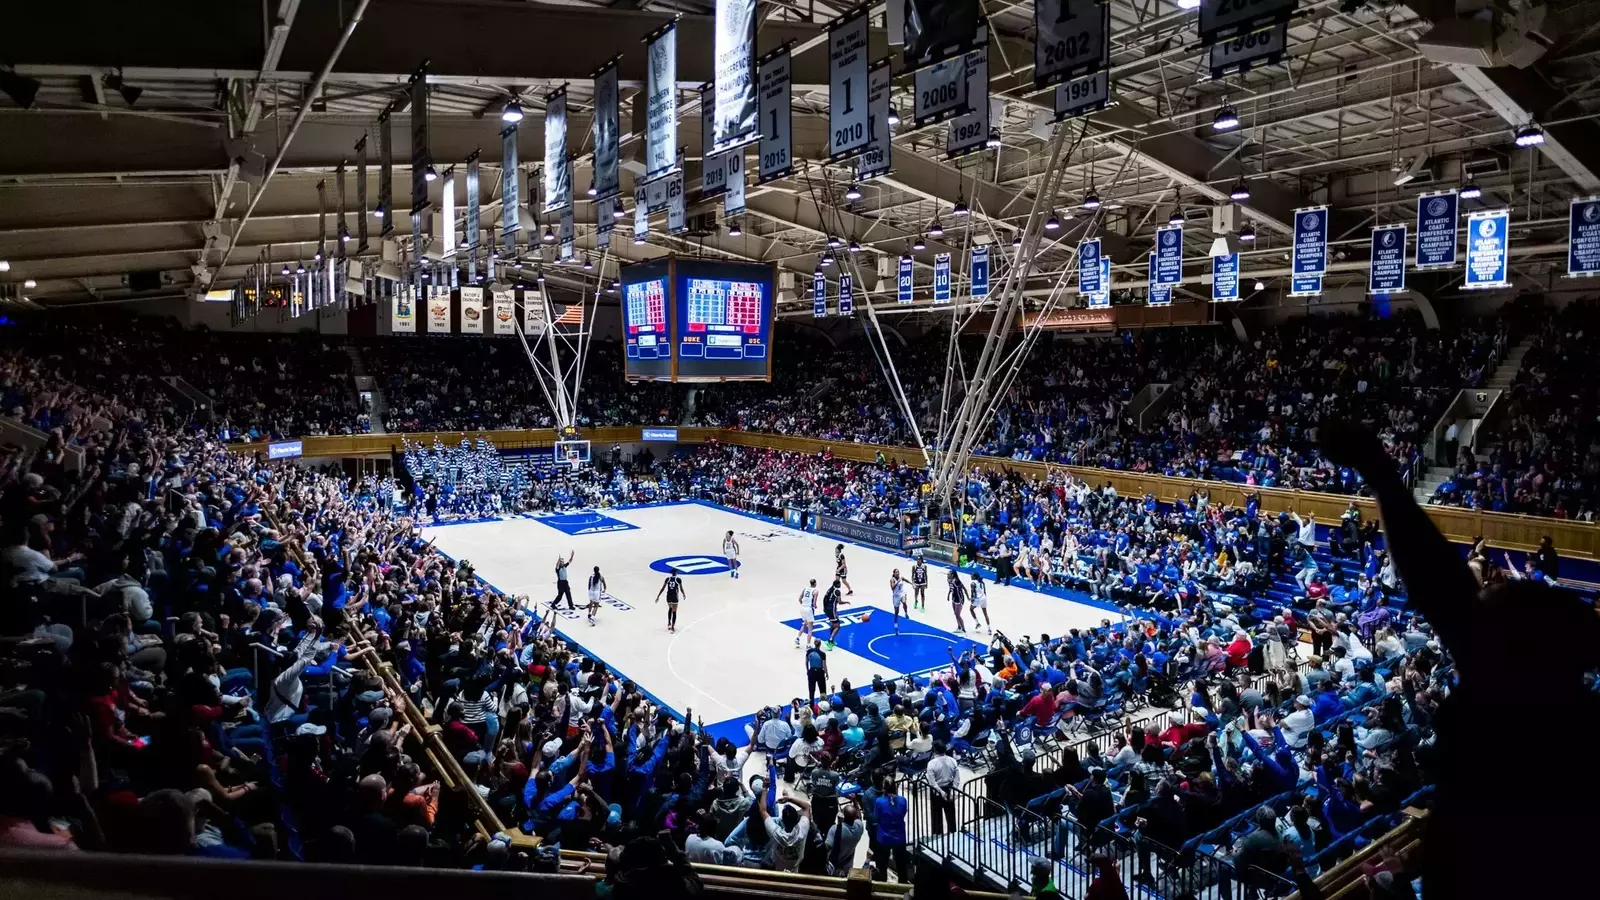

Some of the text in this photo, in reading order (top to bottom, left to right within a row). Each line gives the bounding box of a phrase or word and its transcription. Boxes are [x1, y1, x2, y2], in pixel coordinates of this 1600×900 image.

[1044, 31, 1090, 65] 2002
[842, 77, 854, 115] 1
[922, 81, 958, 110] 2006
[1065, 77, 1097, 102] 1991
[769, 108, 780, 141] 1
[953, 122, 981, 142] 1992
[835, 122, 863, 147] 2010
[728, 154, 739, 176] 10
[764, 153, 786, 170] 2015
[706, 168, 723, 186] 2019
[669, 178, 682, 198] 25
[1424, 217, 1449, 226] ATLANTIC
[1578, 223, 1600, 232] ATLANT
[1420, 229, 1454, 238] CONFERENCE
[1424, 235, 1449, 243] WOMEN'S
[1475, 238, 1500, 246] ATLANTIC
[900, 276, 911, 287] 20
[937, 275, 948, 286] 10
[978, 268, 982, 280] 1
[573, 524, 630, 534] ACC
